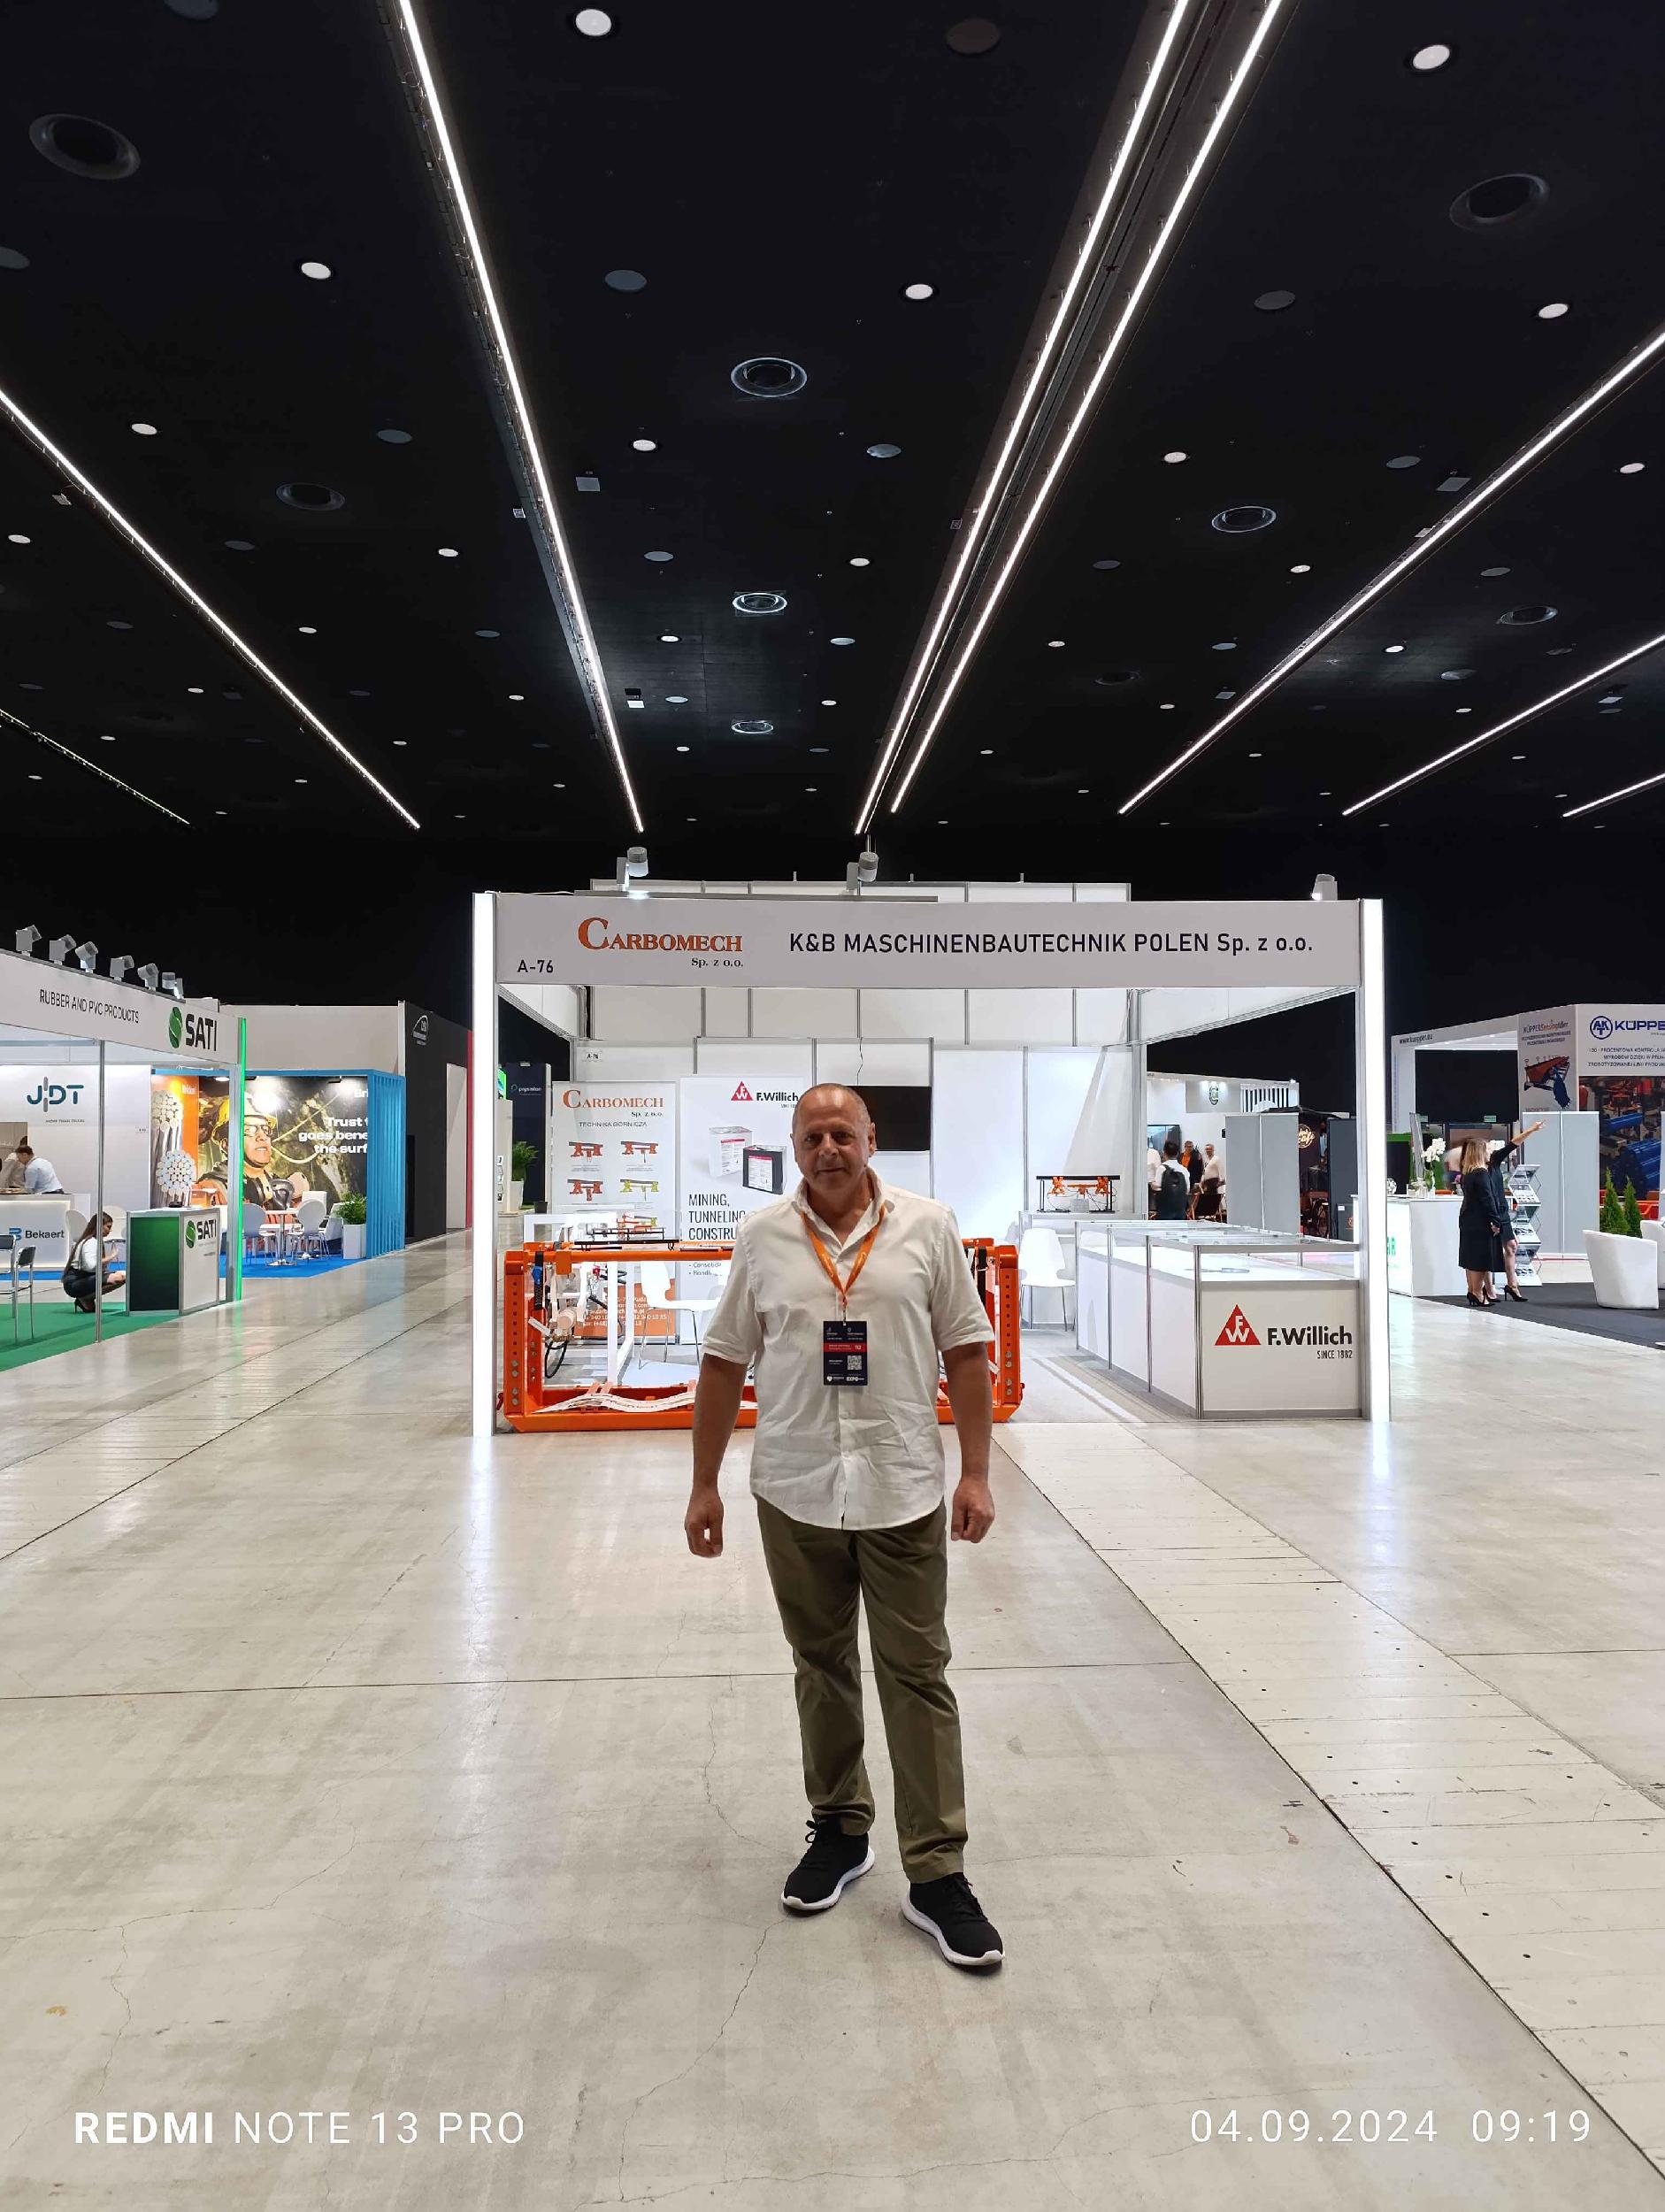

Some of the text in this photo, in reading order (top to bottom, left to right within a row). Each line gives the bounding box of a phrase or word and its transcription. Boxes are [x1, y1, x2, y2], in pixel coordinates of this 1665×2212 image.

[789, 933, 1314, 956] K&B MASCHINENBAUTECHNIK POLEN Sp. z o.o.
[517, 959, 554, 974] A-76
[690, 956, 744, 969] Sp. z o.o.
[40, 988, 140, 1024] RUBBER AND PVC PRODUCTS
[185, 1013, 217, 1052] SATI
[756, 1091, 799, 1102] F.Willich
[326, 1117, 363, 1127] Trust
[298, 1132, 334, 1142] goes
[314, 1143, 336, 1154] the
[688, 1193, 730, 1207] MINING,
[25, 1229, 65, 1239] Bekaert
[196, 1218, 217, 1240] SATI
[1267, 1325, 1353, 1346] F.Willich
[1316, 1349, 1353, 1359] SINCE 1882
